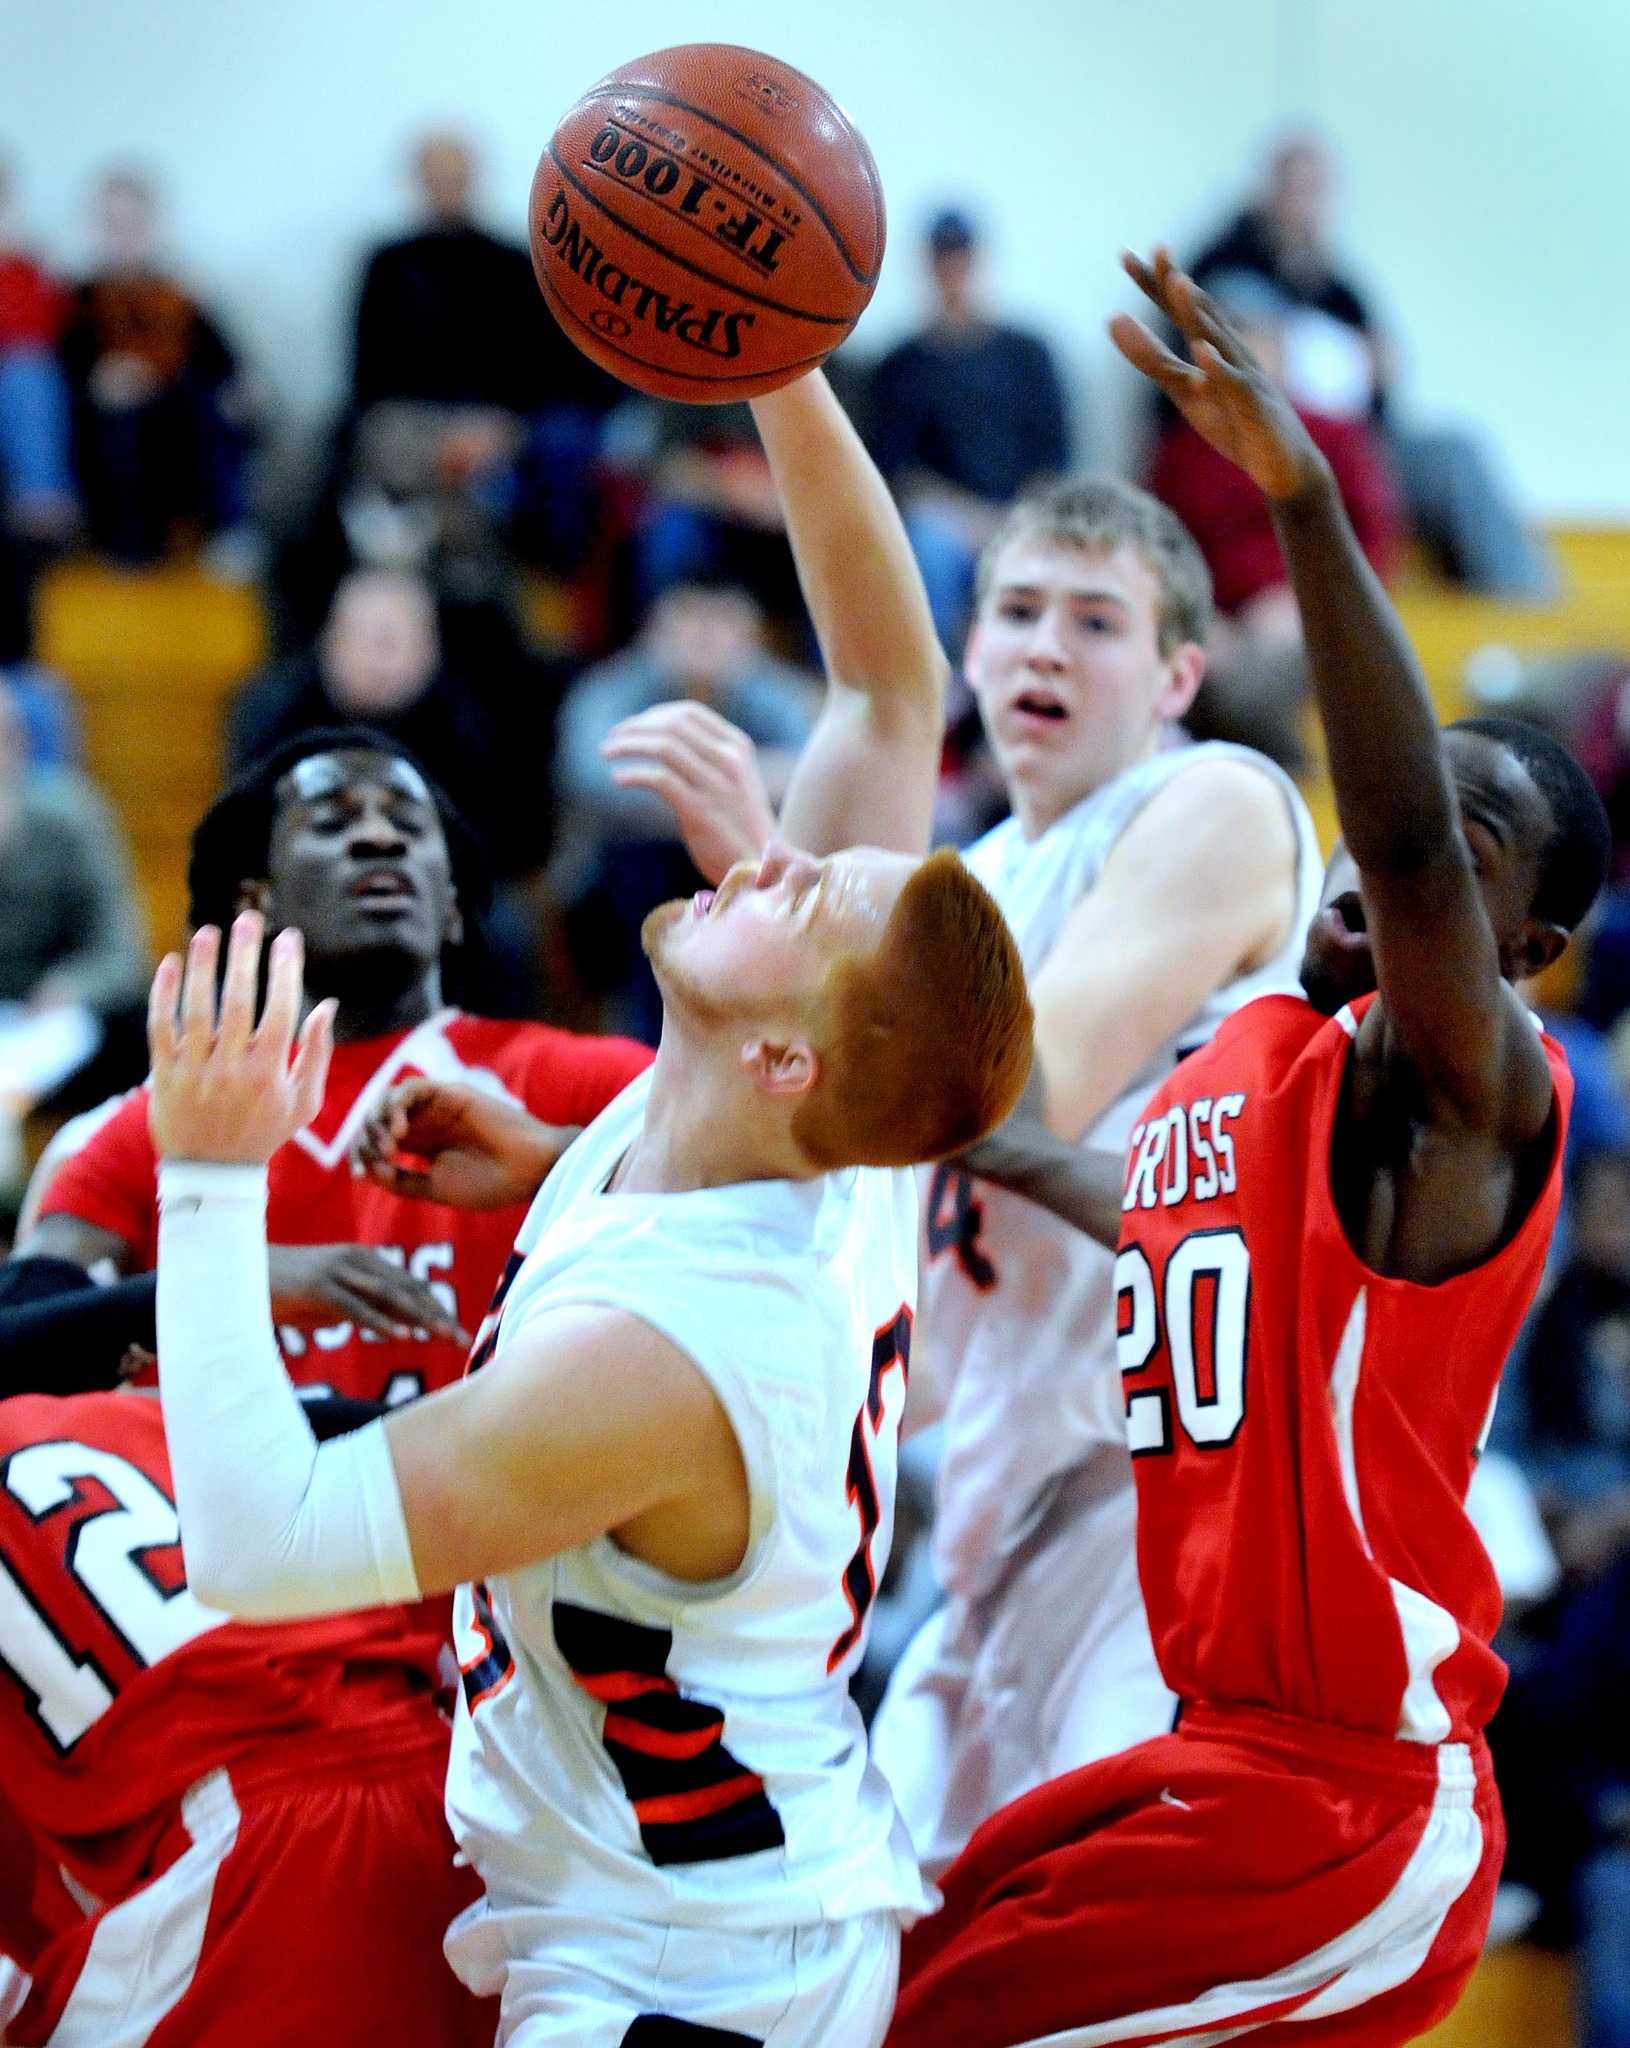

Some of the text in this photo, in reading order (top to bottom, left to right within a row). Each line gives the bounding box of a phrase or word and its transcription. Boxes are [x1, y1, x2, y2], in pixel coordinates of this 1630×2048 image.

[542, 187, 756, 358] SPALDING
[590, 127, 786, 273] TF-1000
[1113, 1225, 1252, 1458] 20
[0, 1440, 233, 1758] 12
